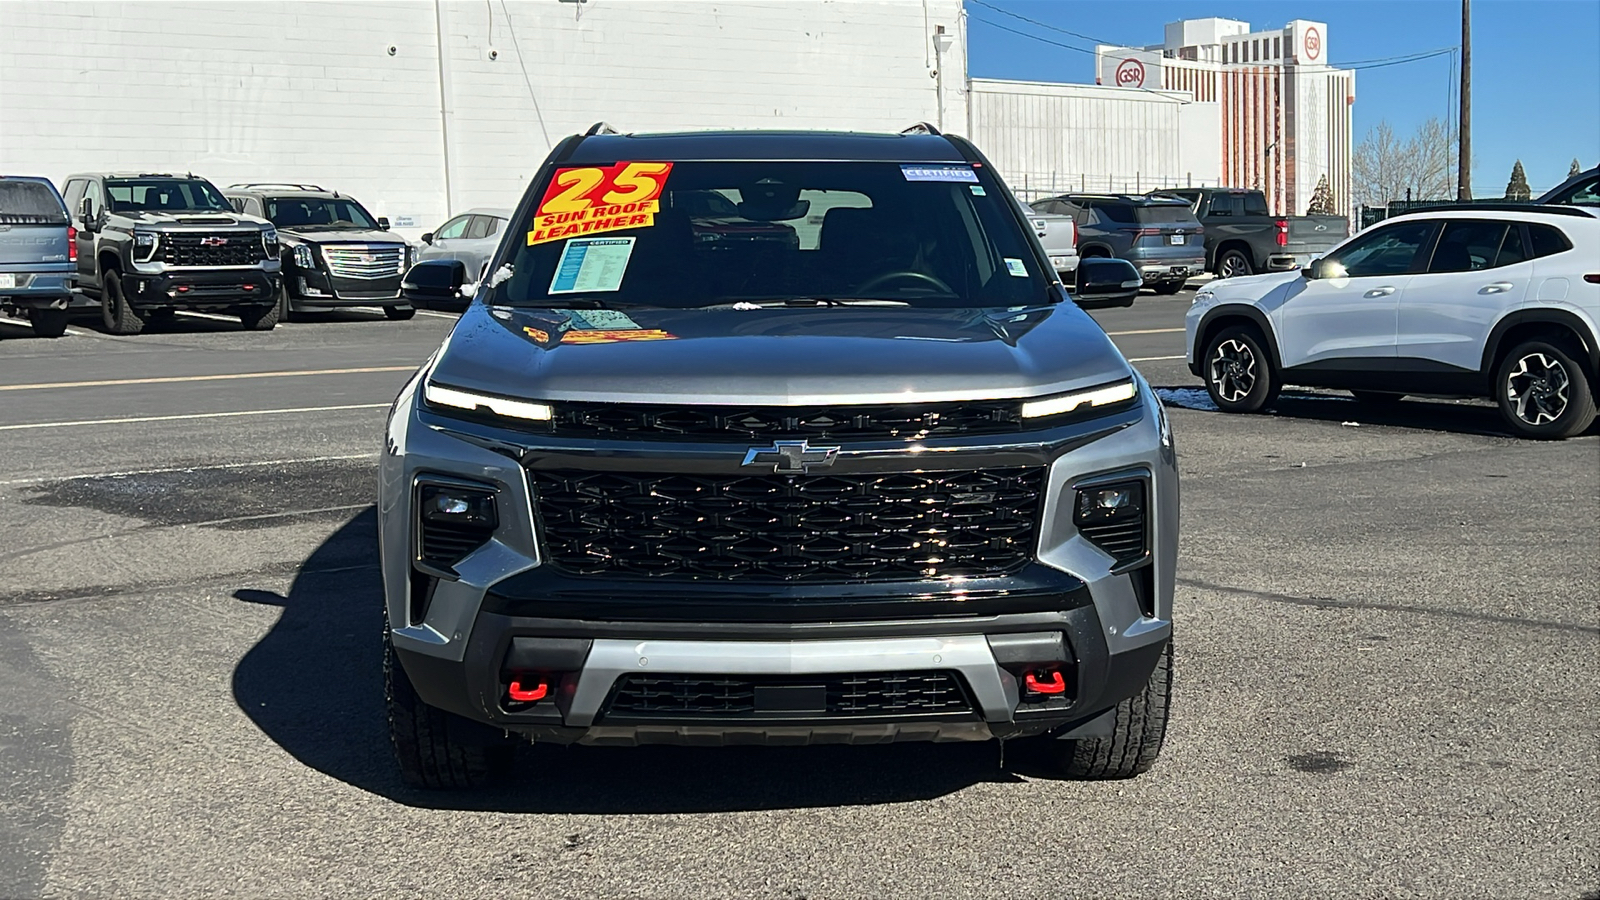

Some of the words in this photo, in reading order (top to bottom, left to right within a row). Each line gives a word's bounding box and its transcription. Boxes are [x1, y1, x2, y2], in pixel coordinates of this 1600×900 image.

[1306, 36, 1318, 50] GSR
[1119, 67, 1141, 83] GSR
[906, 169, 972, 178] CERTIFIED
[541, 162, 669, 214] 25
[541, 210, 587, 227] SUN
[592, 201, 653, 217] ROOF
[533, 213, 648, 242] LEATHER
